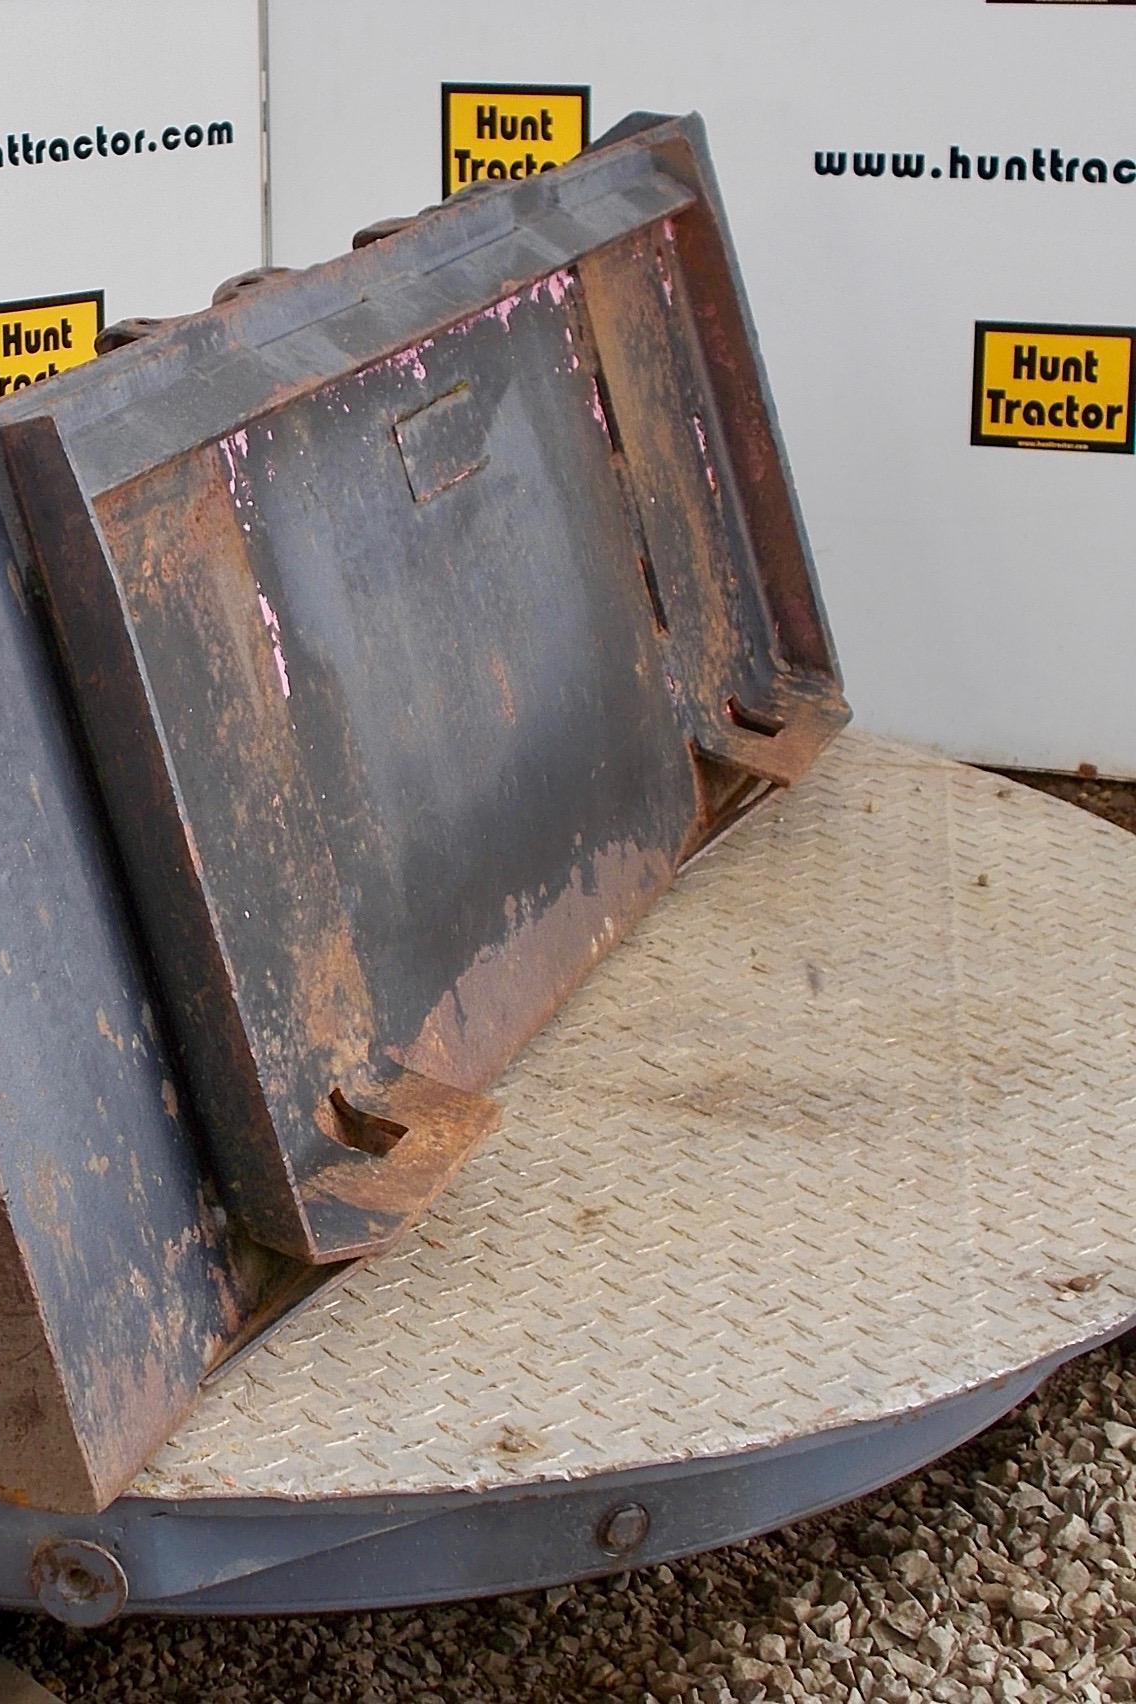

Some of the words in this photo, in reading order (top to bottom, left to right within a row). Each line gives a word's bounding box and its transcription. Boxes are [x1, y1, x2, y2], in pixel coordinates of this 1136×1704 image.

[476, 105, 553, 141] Hunt
[2, 318, 72, 358] Hunt
[1013, 344, 1099, 383] Hunt
[986, 389, 1123, 430] Tractor
